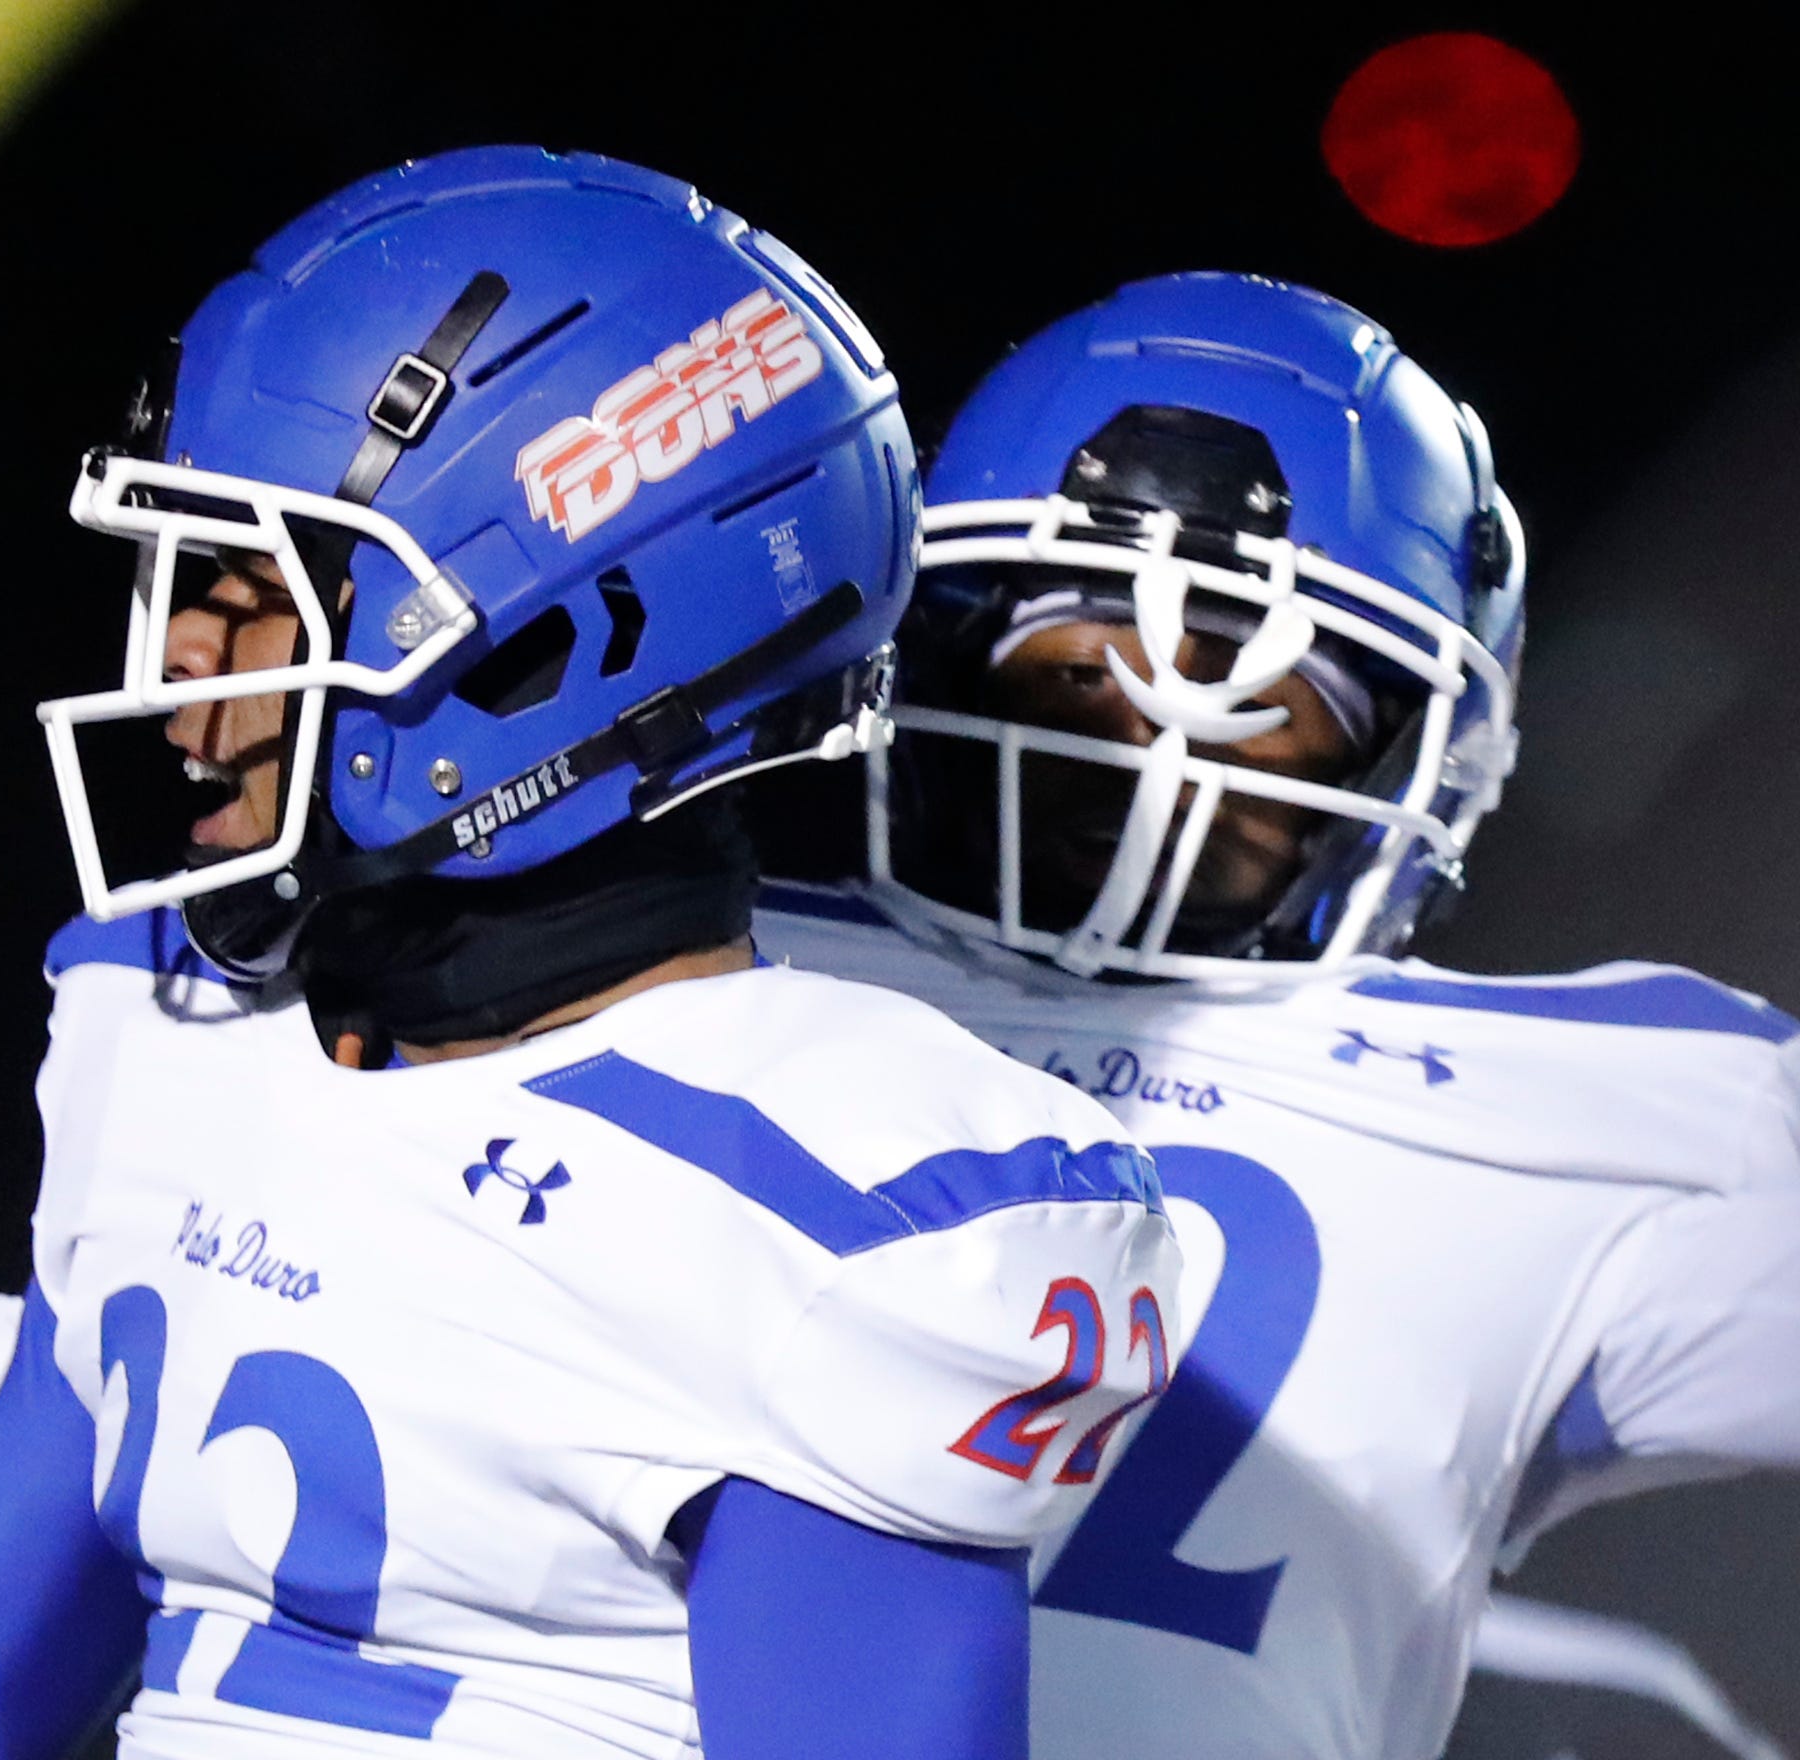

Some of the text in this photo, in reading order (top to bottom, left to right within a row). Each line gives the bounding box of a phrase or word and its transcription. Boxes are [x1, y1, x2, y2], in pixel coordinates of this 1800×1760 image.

[515, 287, 824, 544] DONS
[452, 753, 576, 849] schutt
[1089, 1047, 1226, 1114] Duro
[218, 1219, 321, 1302] Duro
[946, 1275, 1169, 1485] 22
